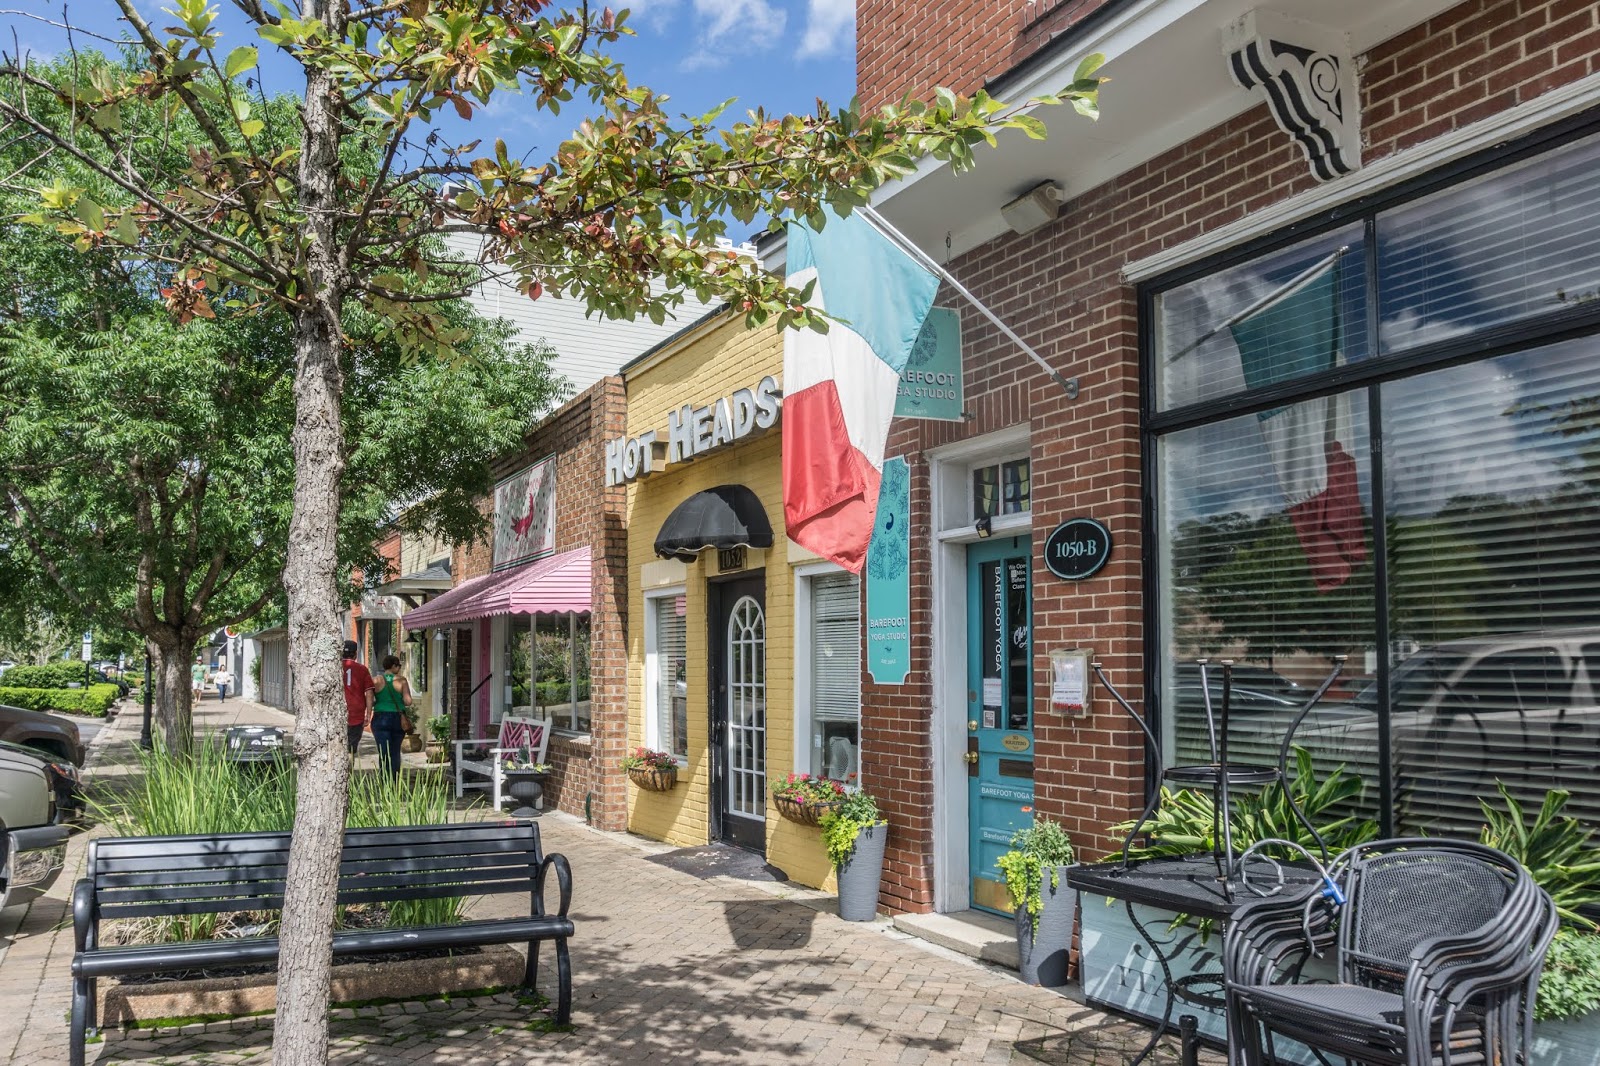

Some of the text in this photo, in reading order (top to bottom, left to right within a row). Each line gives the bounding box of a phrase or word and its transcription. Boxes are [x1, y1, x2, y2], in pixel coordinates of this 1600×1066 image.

[900, 369, 955, 386] EFOOT
[915, 387, 956, 400] STUDIO
[605, 429, 655, 487] HOT
[668, 375, 781, 464] HEADS
[1056, 539, 1097, 558] 1050-B
[722, 549, 741, 568] 1052
[994, 566, 1002, 634] BAREFOOT
[870, 617, 907, 629] BAREFOOT
[871, 632, 907, 641] YOGA STUDIO
[345, 668, 352, 687] 1
[981, 786, 1012, 797] BAREFOOT
[1012, 791, 1030, 800] YOGA
